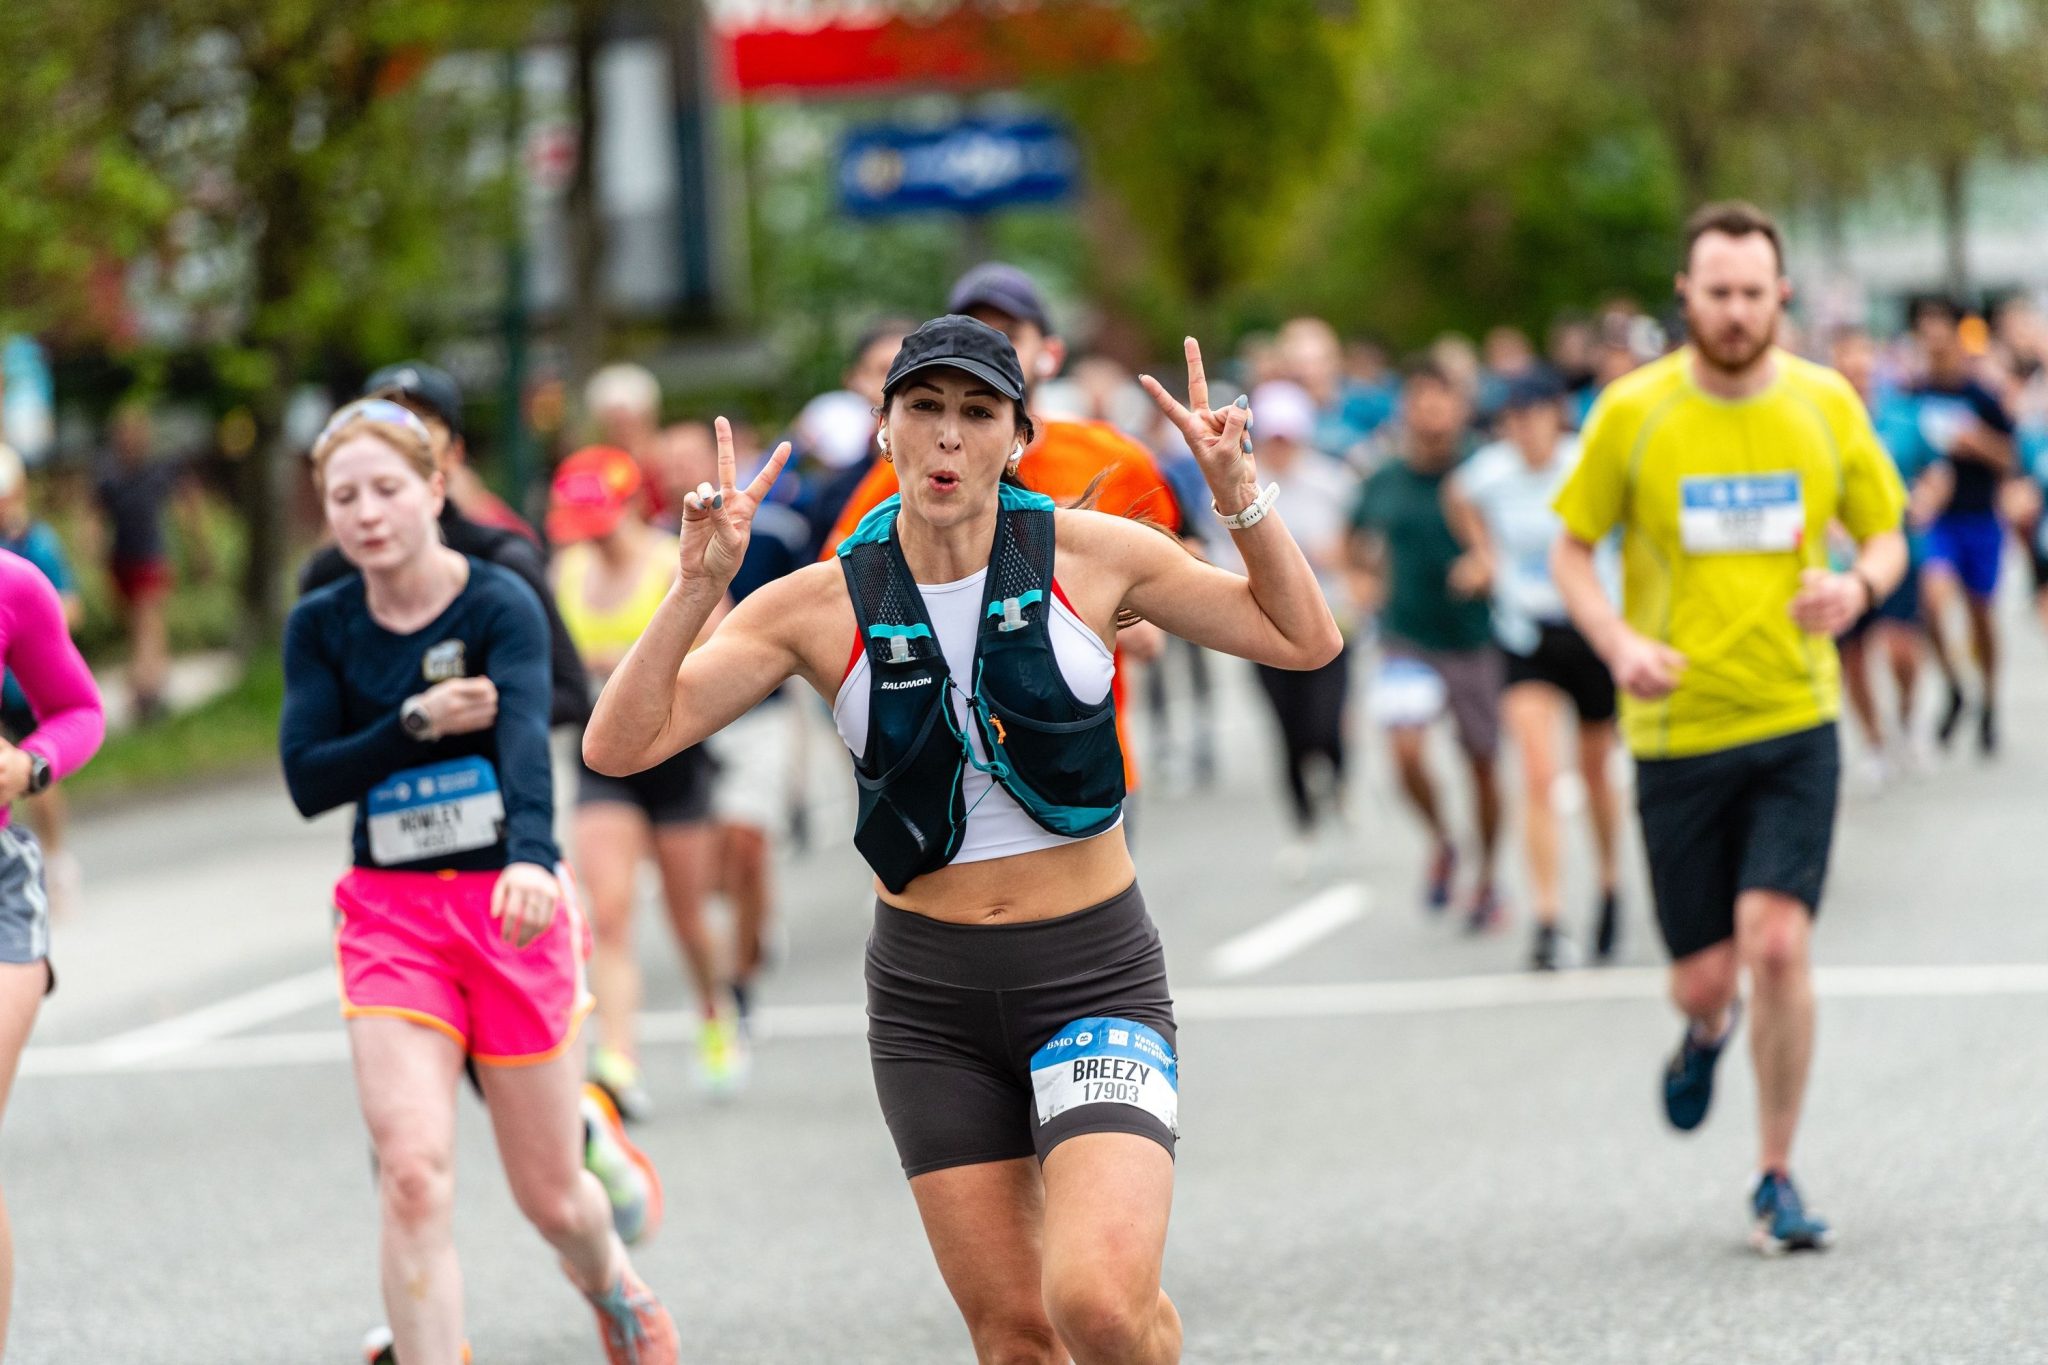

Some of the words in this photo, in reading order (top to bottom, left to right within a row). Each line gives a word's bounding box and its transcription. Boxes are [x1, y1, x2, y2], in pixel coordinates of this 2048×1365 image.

[881, 677, 932, 690] SALOMON
[1047, 1037, 1074, 1050] BMO
[1073, 1058, 1150, 1086] BREEZY
[1083, 1082, 1139, 1103] 17903
